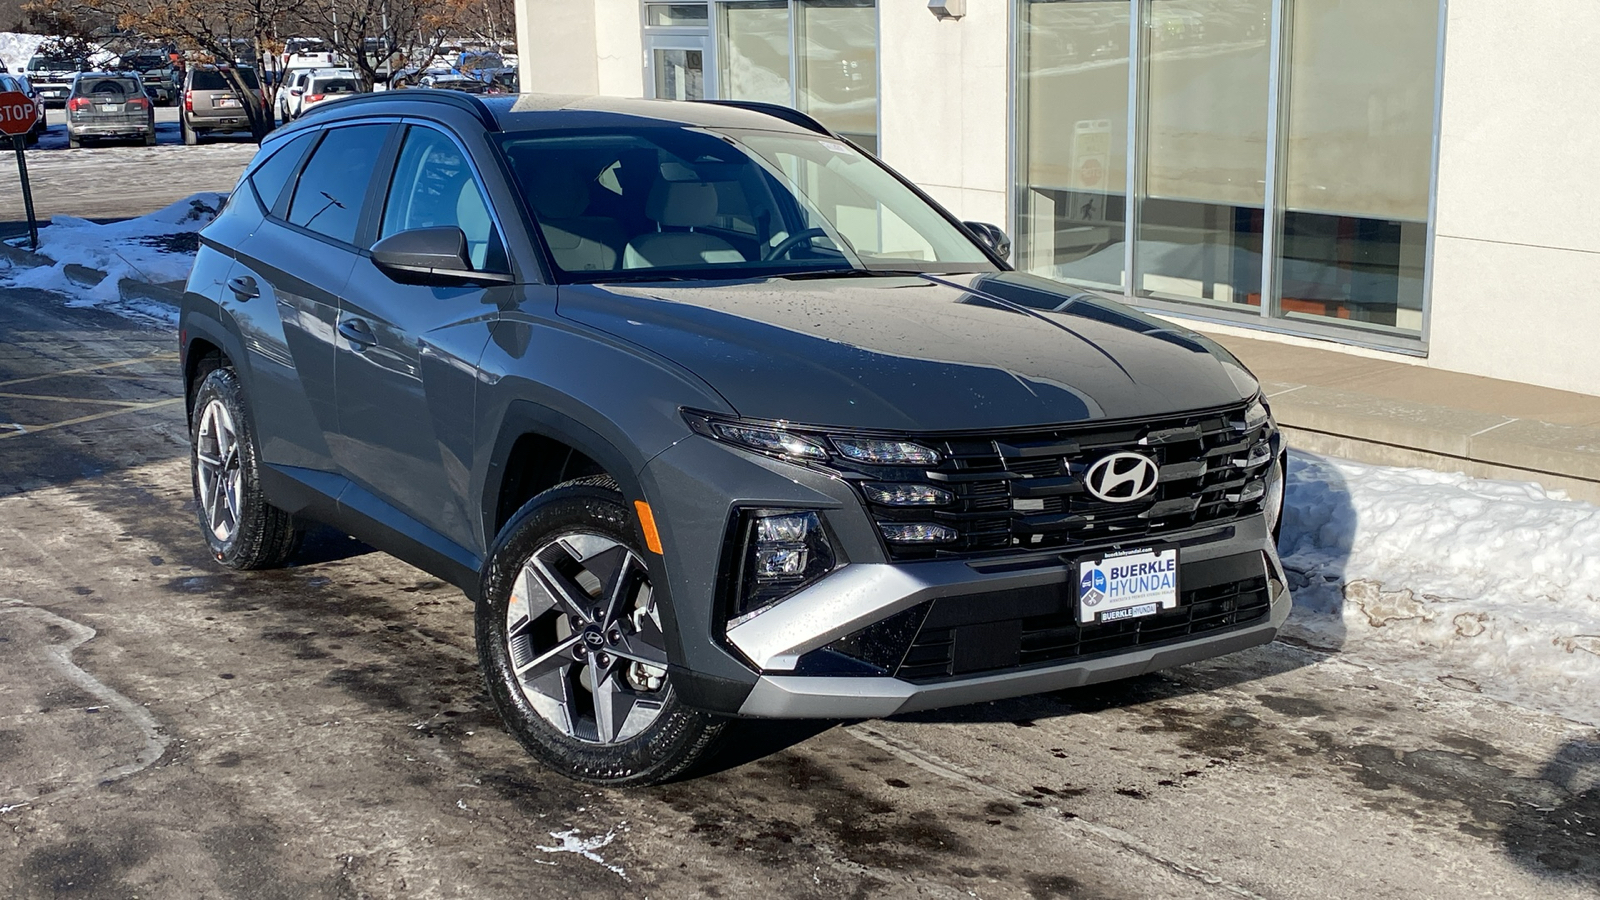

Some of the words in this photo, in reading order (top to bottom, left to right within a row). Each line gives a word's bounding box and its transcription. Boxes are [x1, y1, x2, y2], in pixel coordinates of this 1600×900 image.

[1111, 559, 1174, 580] BUERKLE
[1110, 572, 1175, 597] HYUNDAI
[1103, 609, 1132, 620] BUERKLE
[1134, 605, 1155, 616] HYUNDAI
